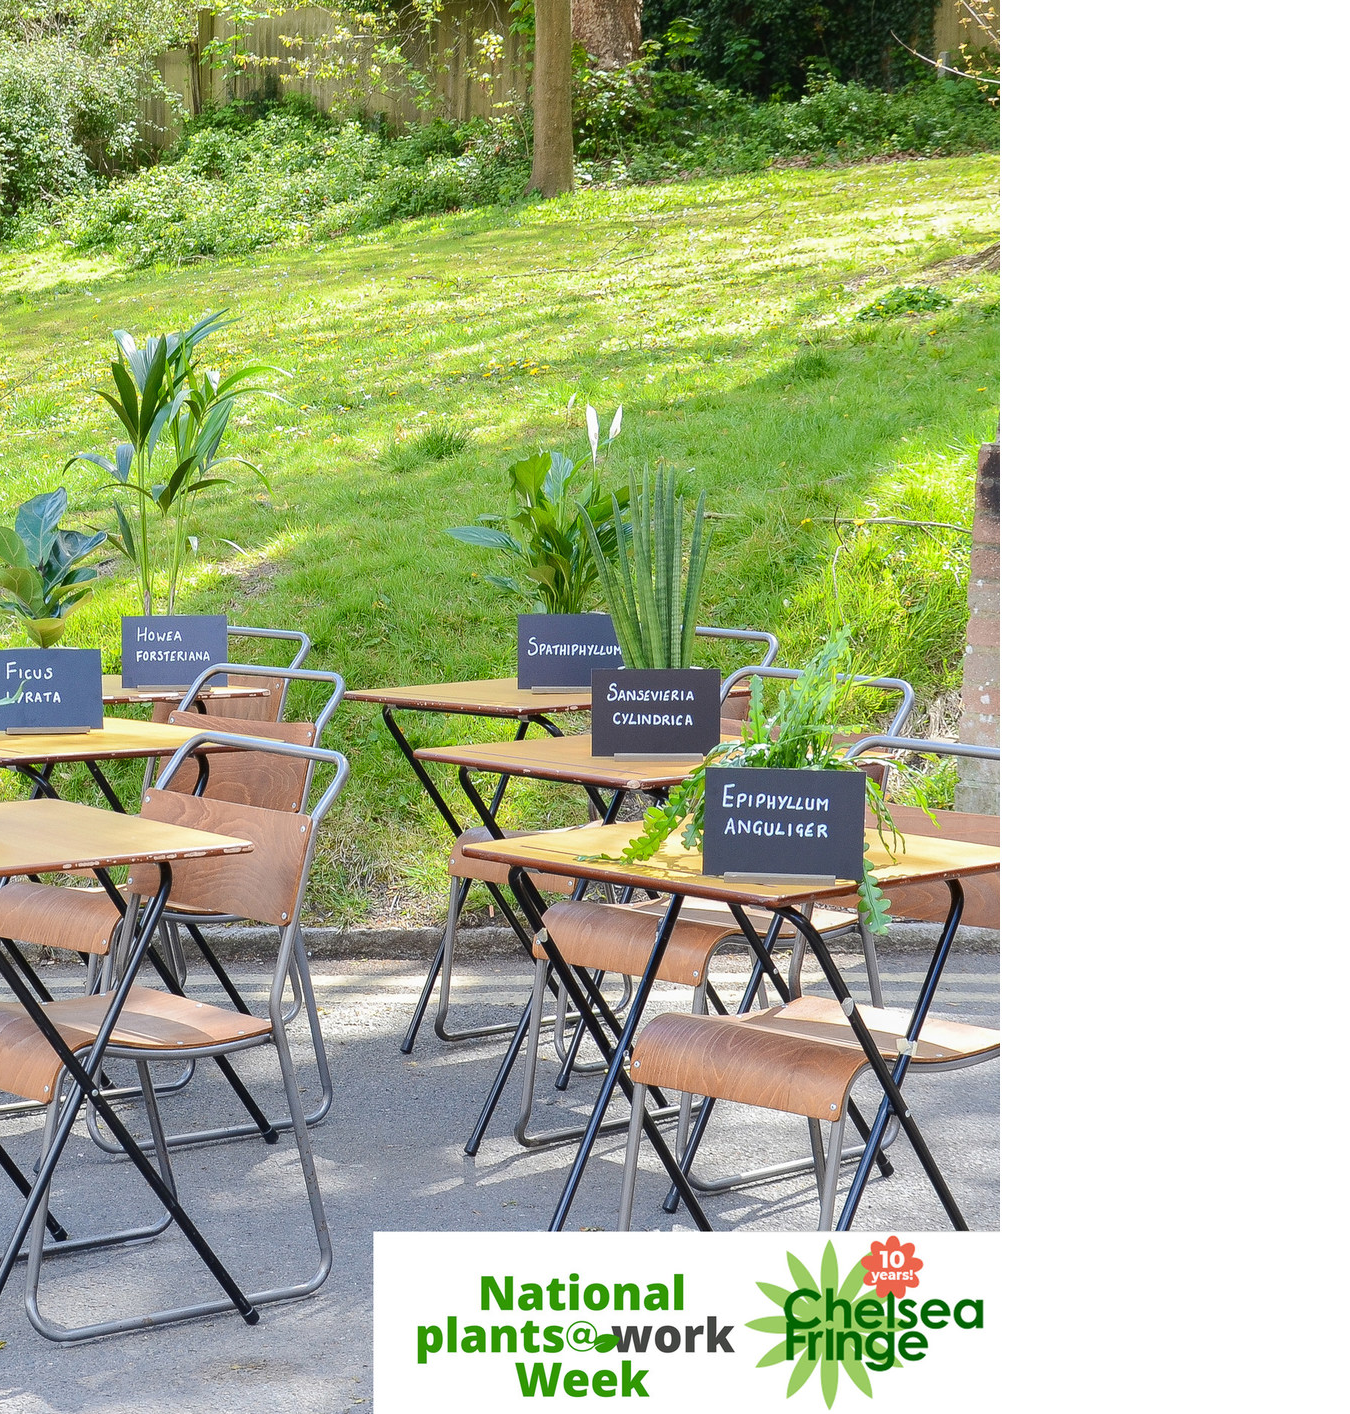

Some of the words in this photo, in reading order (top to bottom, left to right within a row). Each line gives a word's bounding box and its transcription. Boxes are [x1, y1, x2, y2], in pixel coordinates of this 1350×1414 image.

[136, 627, 182, 642] HOWEA
[527, 636, 622, 656] SPATHIPHYLLUM
[136, 650, 211, 663] FORSTERIANA
[6, 661, 53, 680] FICUS
[606, 682, 695, 702] SANSEVIERIA
[612, 711, 694, 727] CYLINDRICA
[722, 783, 829, 812] EPIPHYLLUM
[724, 817, 829, 839] ANGULIGER
